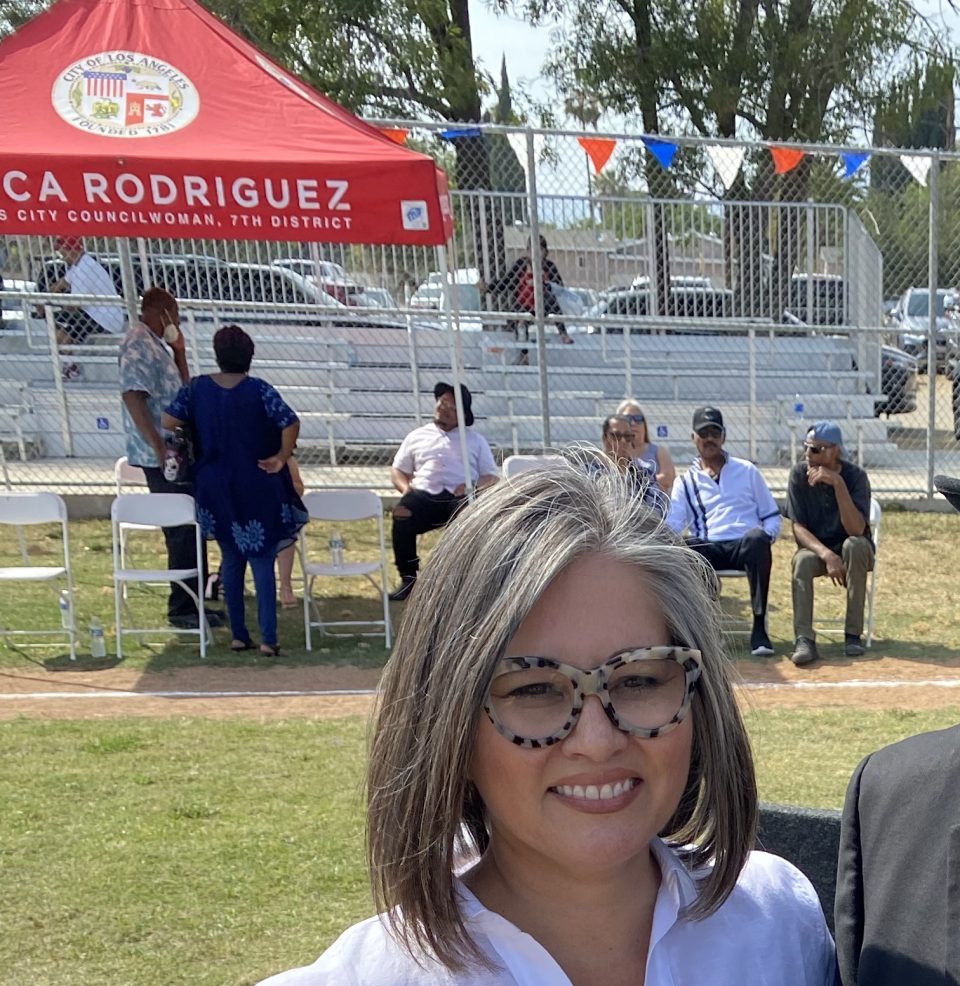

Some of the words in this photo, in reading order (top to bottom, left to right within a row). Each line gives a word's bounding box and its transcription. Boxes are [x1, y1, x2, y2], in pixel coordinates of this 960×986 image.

[63, 64, 86, 83] CITY
[86, 56, 102, 67] OF
[108, 53, 135, 63] LOS
[139, 57, 190, 90] ANGELES
[72, 117, 138, 136] FOUNDED
[147, 122, 176, 136] 1781
[3, 170, 68, 202] CA
[83, 172, 351, 211] RODRIGUEZ
[17, 209, 57, 222] CITY
[68, 210, 222, 228] COUNCILWOMAN,
[230, 214, 263, 227] 7TH
[271, 215, 352, 230] DISTRICT
